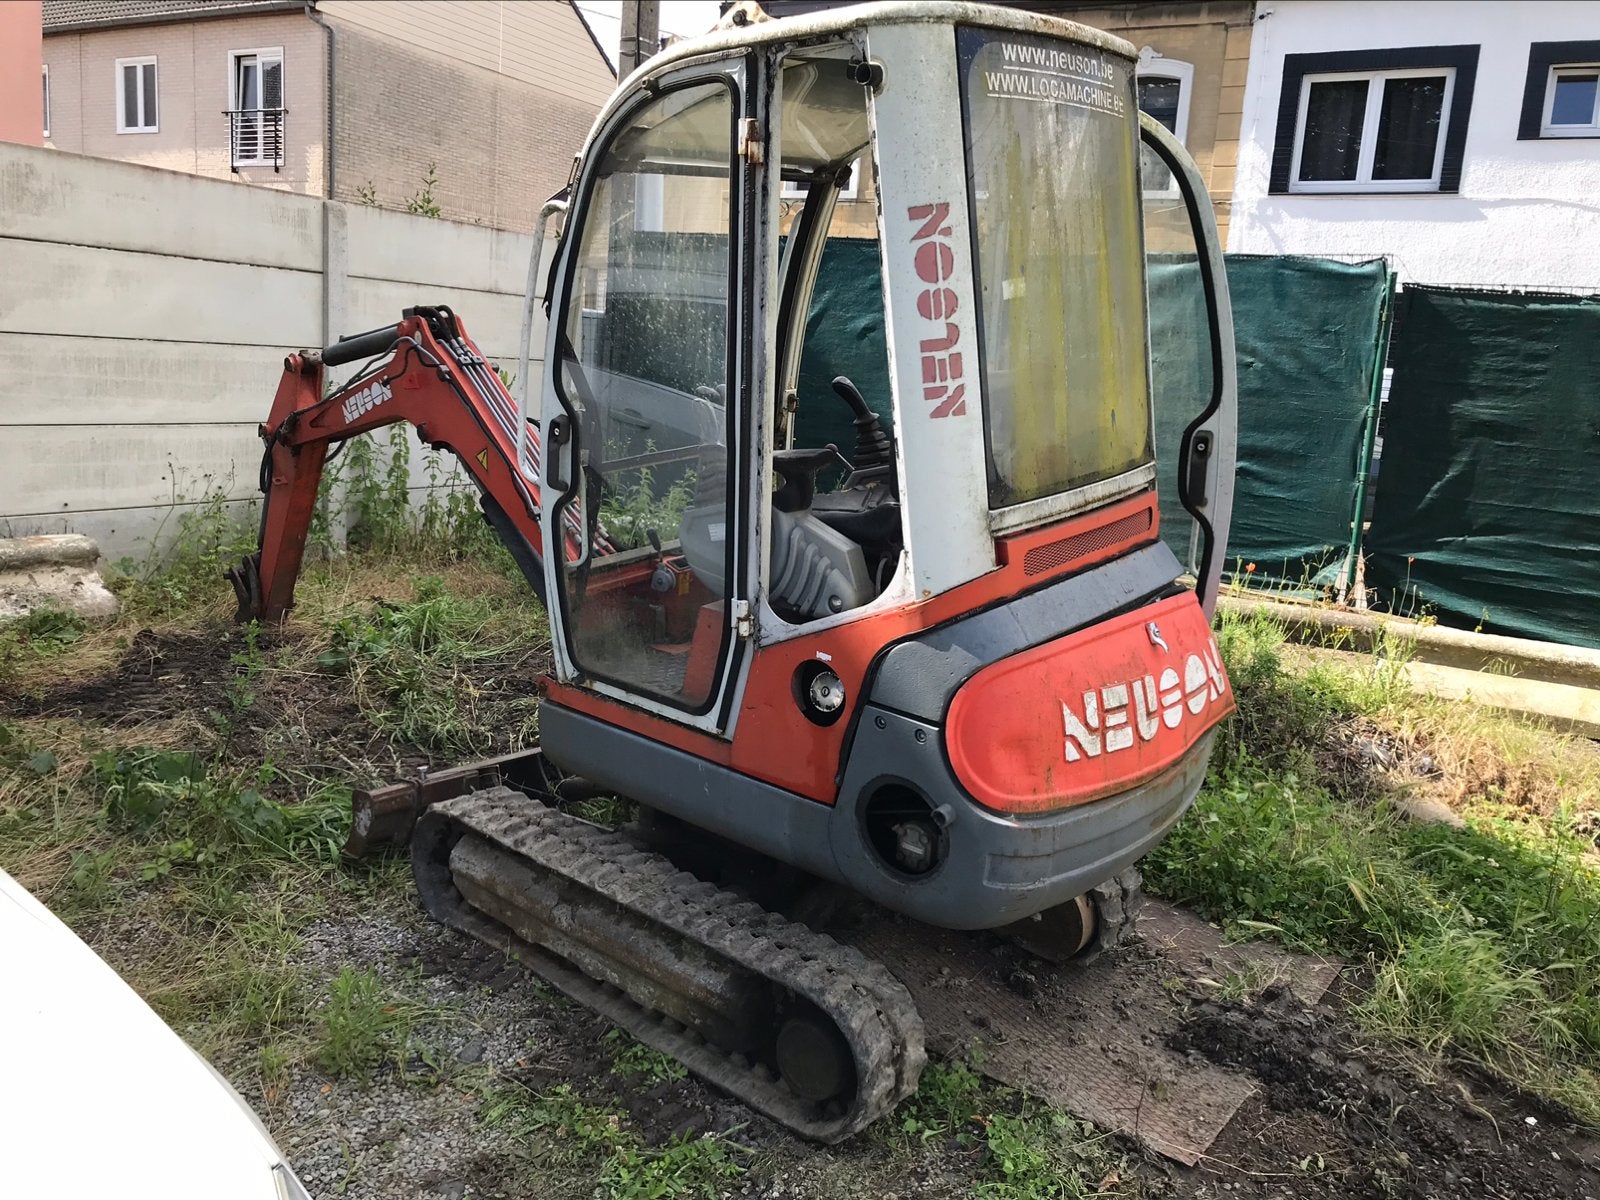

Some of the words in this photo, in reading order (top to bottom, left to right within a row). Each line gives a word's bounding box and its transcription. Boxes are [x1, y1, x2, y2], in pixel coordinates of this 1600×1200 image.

[1002, 42, 1113, 81] www.neuson.be
[985, 71, 1124, 112] WWW.LOCAMACHINE.BE
[907, 202, 966, 419] NEUSON
[341, 375, 393, 424] NEUSON
[1060, 637, 1226, 762] NEUSON
